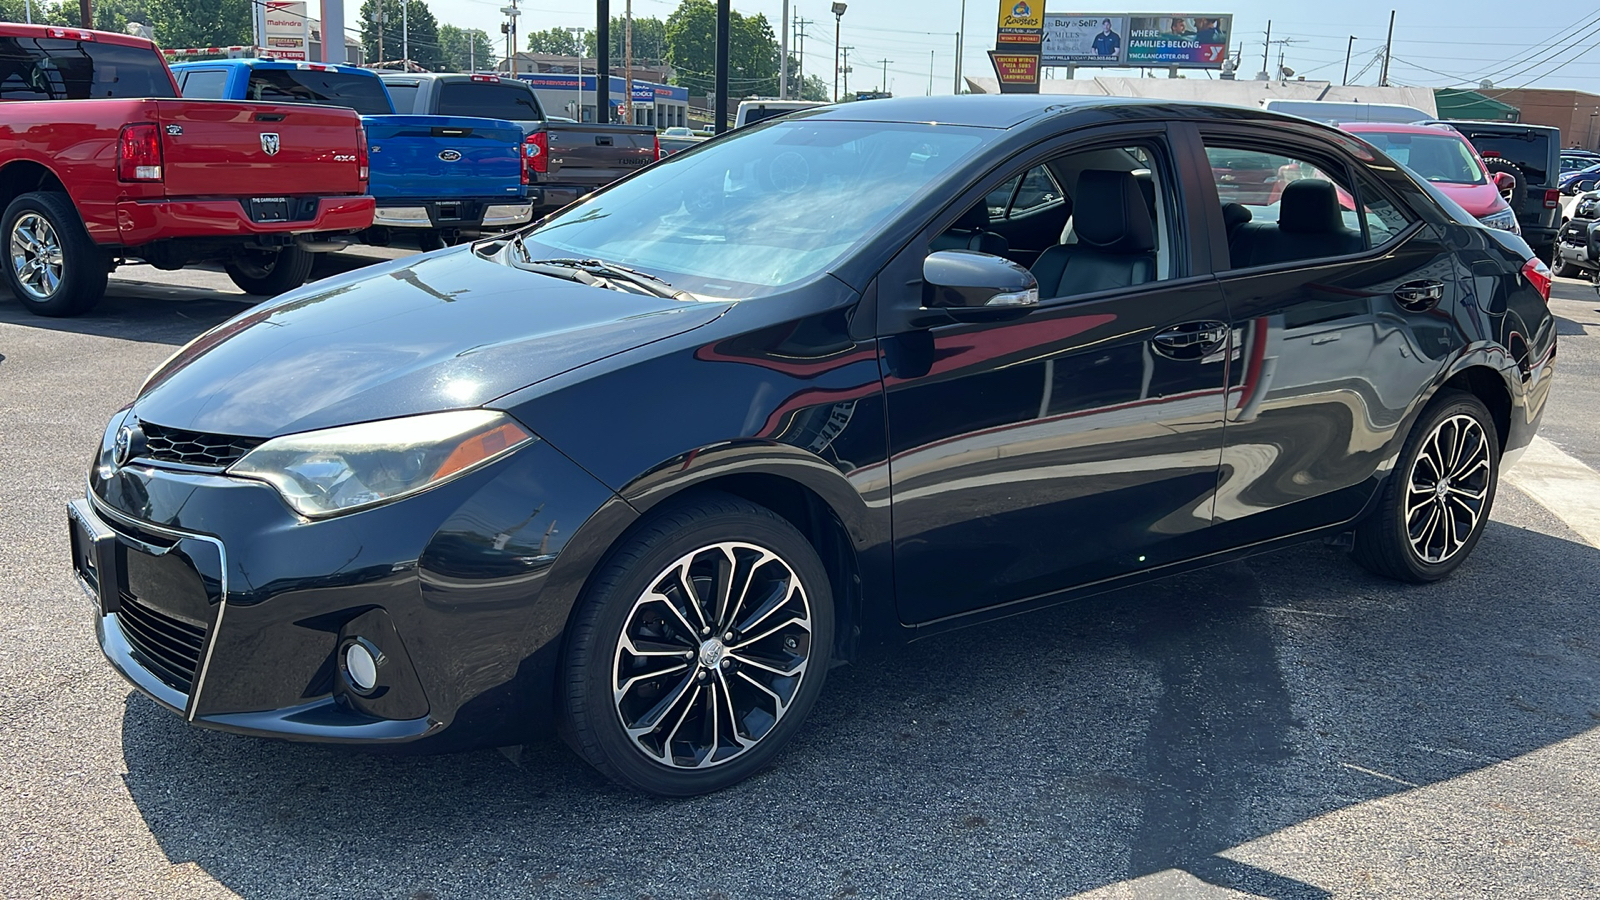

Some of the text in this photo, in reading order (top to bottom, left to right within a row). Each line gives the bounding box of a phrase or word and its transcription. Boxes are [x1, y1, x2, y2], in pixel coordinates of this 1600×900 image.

[1004, 15, 1039, 26] Roosters
[1055, 20, 1070, 28] Buy
[1131, 30, 1160, 38] WHERE
[1130, 40, 1166, 48] FAMILIES
